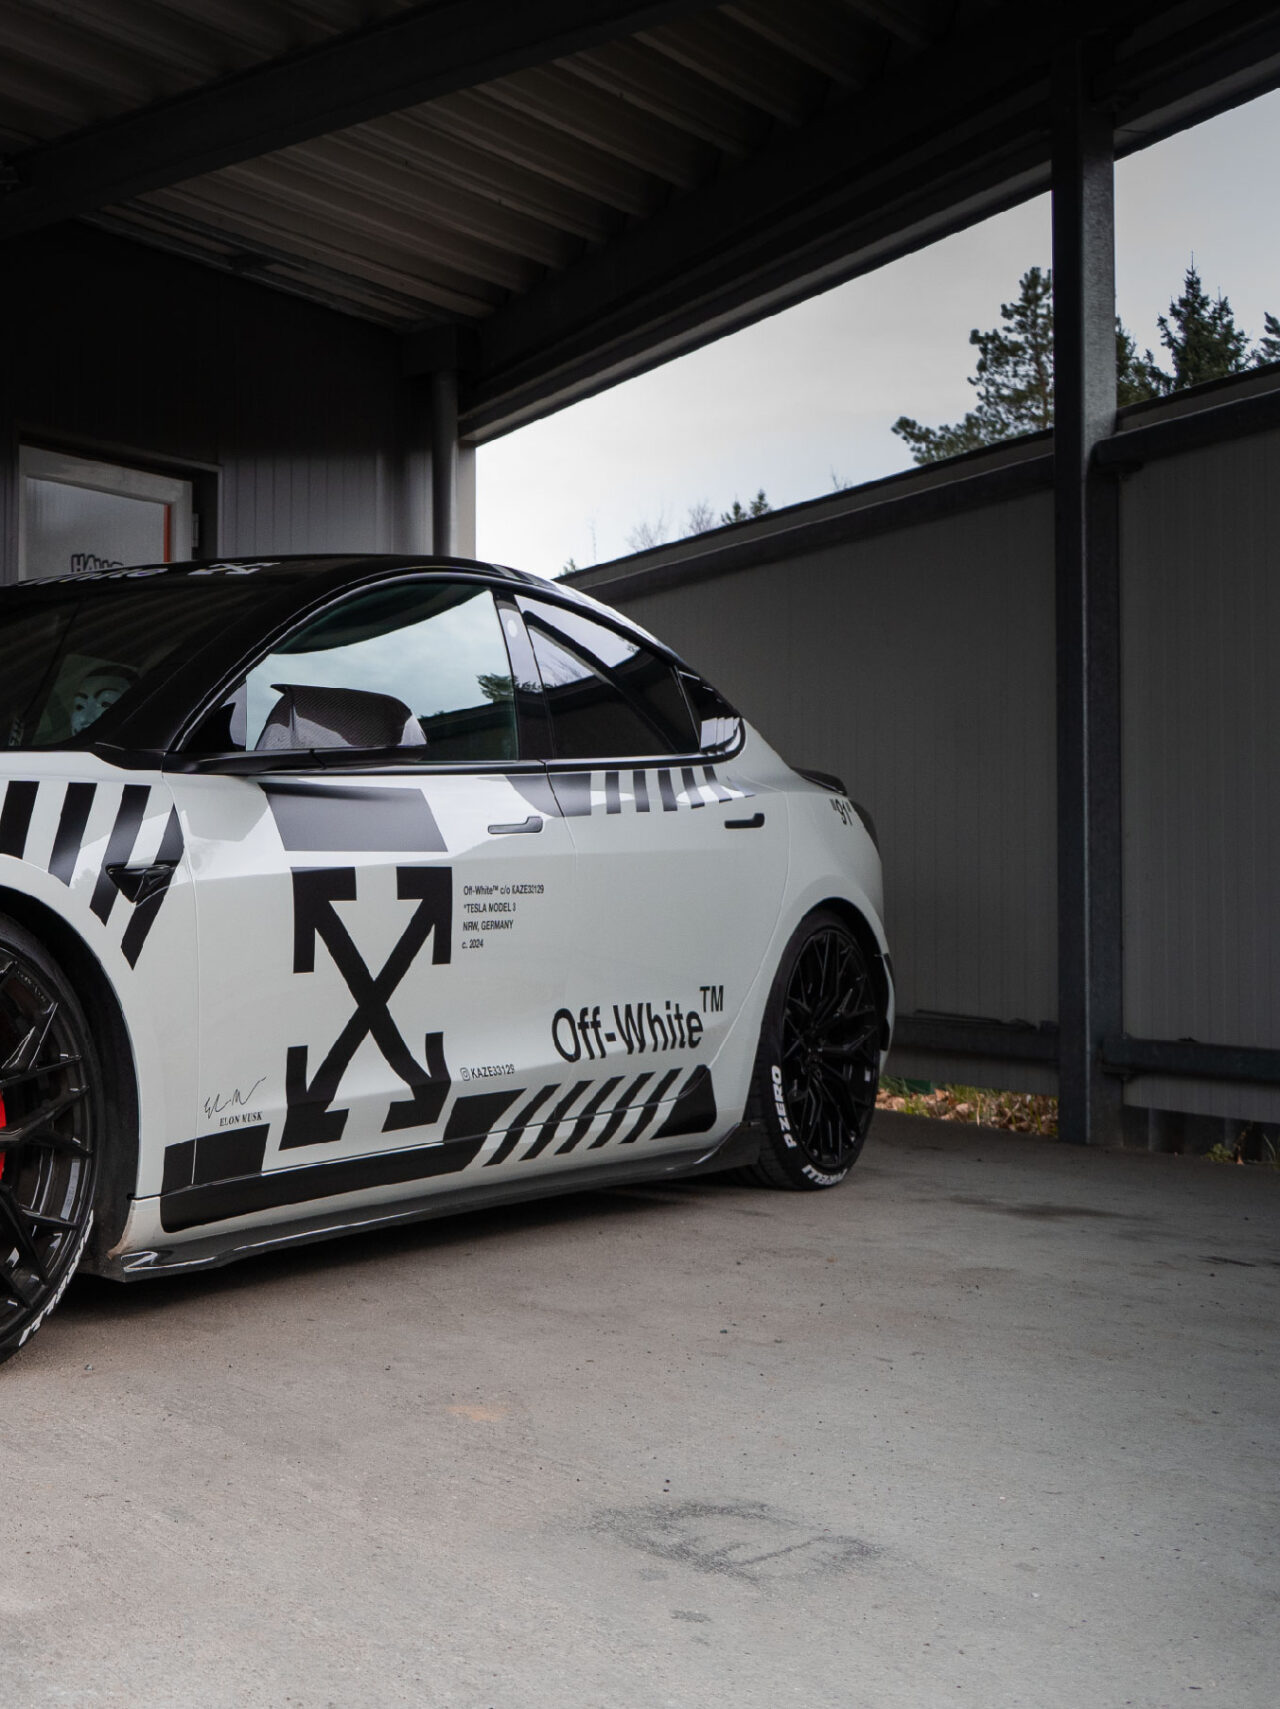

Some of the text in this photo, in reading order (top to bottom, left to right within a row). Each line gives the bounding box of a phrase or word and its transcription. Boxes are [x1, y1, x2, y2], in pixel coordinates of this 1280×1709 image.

[481, 919, 514, 931] GERMANY
[469, 938, 484, 949] 2024
[219, 1115, 240, 1127] ELON
